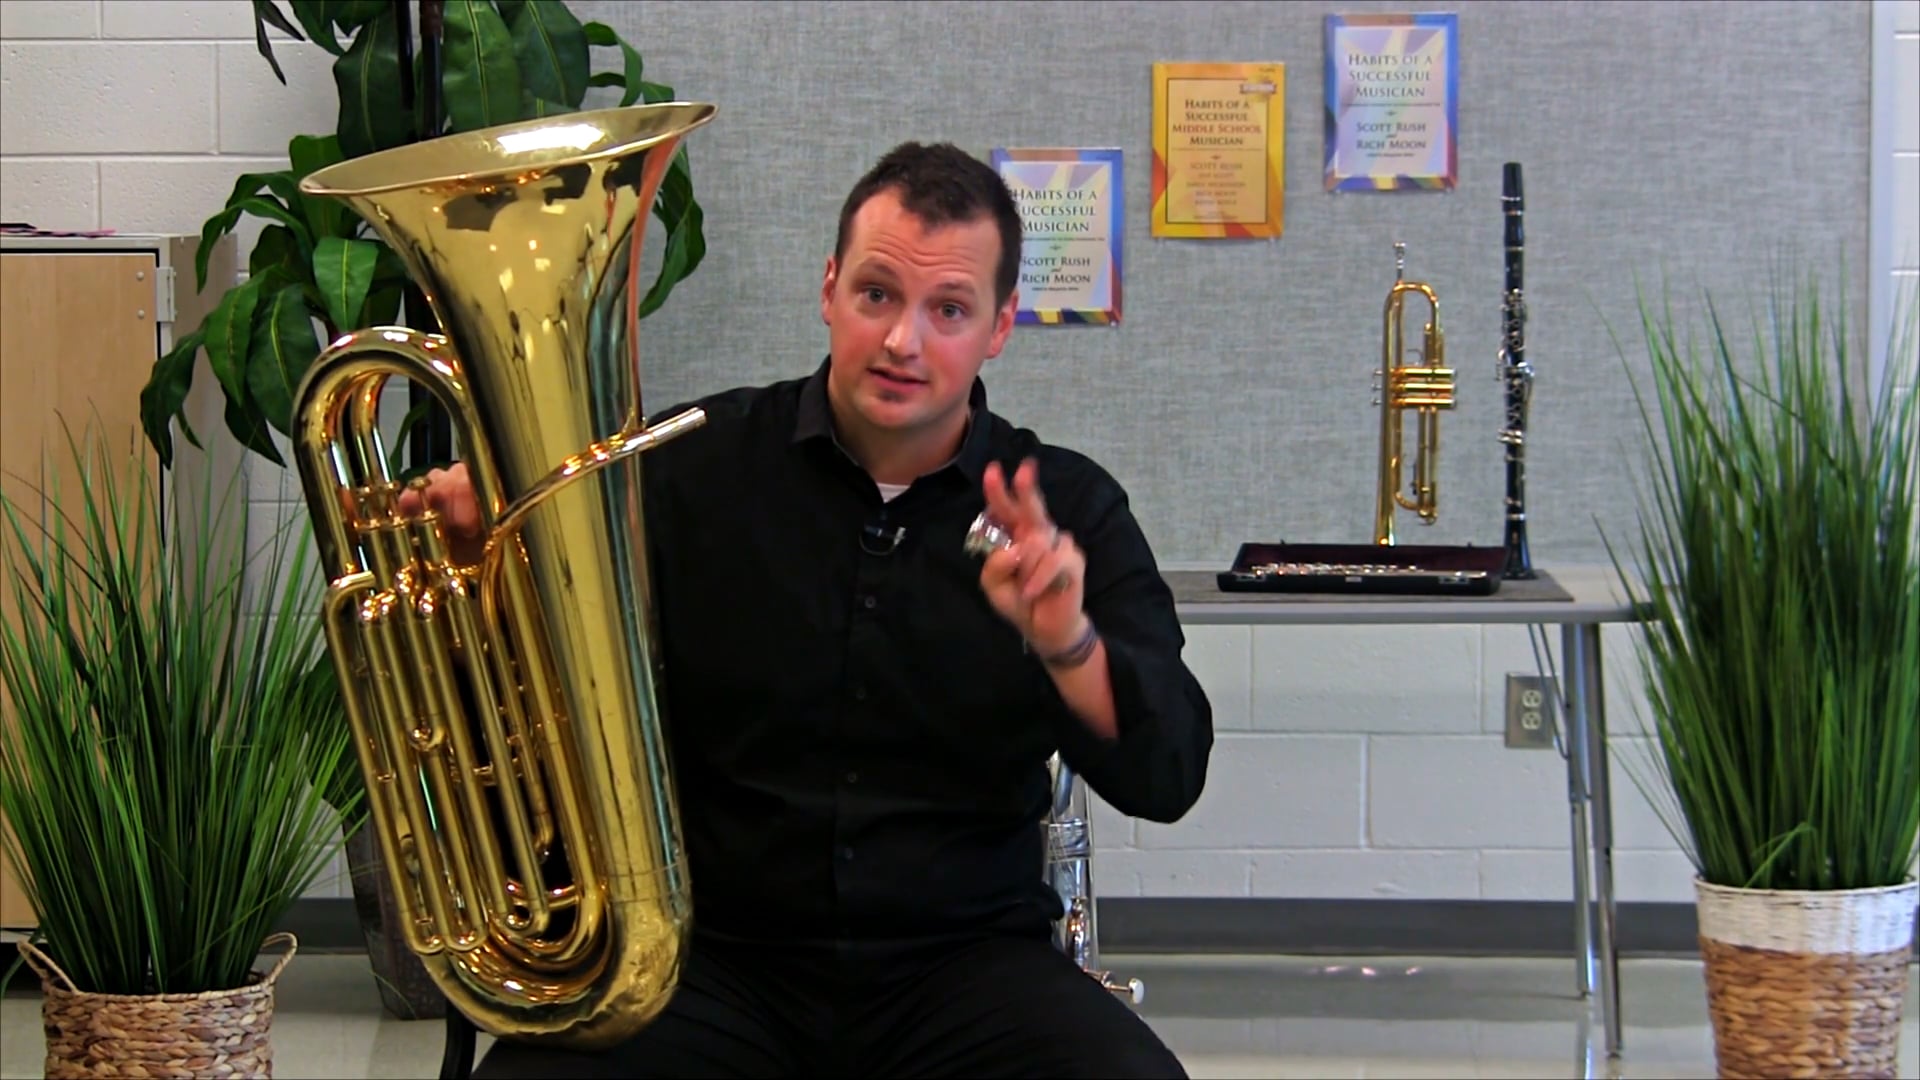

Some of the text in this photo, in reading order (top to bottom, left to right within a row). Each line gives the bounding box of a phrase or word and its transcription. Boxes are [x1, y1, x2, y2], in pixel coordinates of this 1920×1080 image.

[1348, 53, 1433, 65] HABITS OF A
[1349, 70, 1431, 81] SUCCESSFUL
[1355, 86, 1426, 97] MUSICIAN
[1184, 98, 1250, 109] HABITS OF A
[1185, 112, 1248, 121] SUCCESSFUL
[1172, 123, 1262, 134] MIDDLE SCHOOL
[1356, 122, 1426, 132] SCOTT RUSH
[1189, 136, 1244, 145] MUSICIAN
[1356, 139, 1427, 149] RICH MOON
[1066, 189, 1084, 200] OF
[1088, 190, 1097, 200] A
[1019, 205, 1097, 216] UCCESSFUL
[1021, 220, 1090, 232] MUSICIAN
[1023, 256, 1091, 266] SCOTT RUSH
[1022, 273, 1091, 283] RICH MOON
